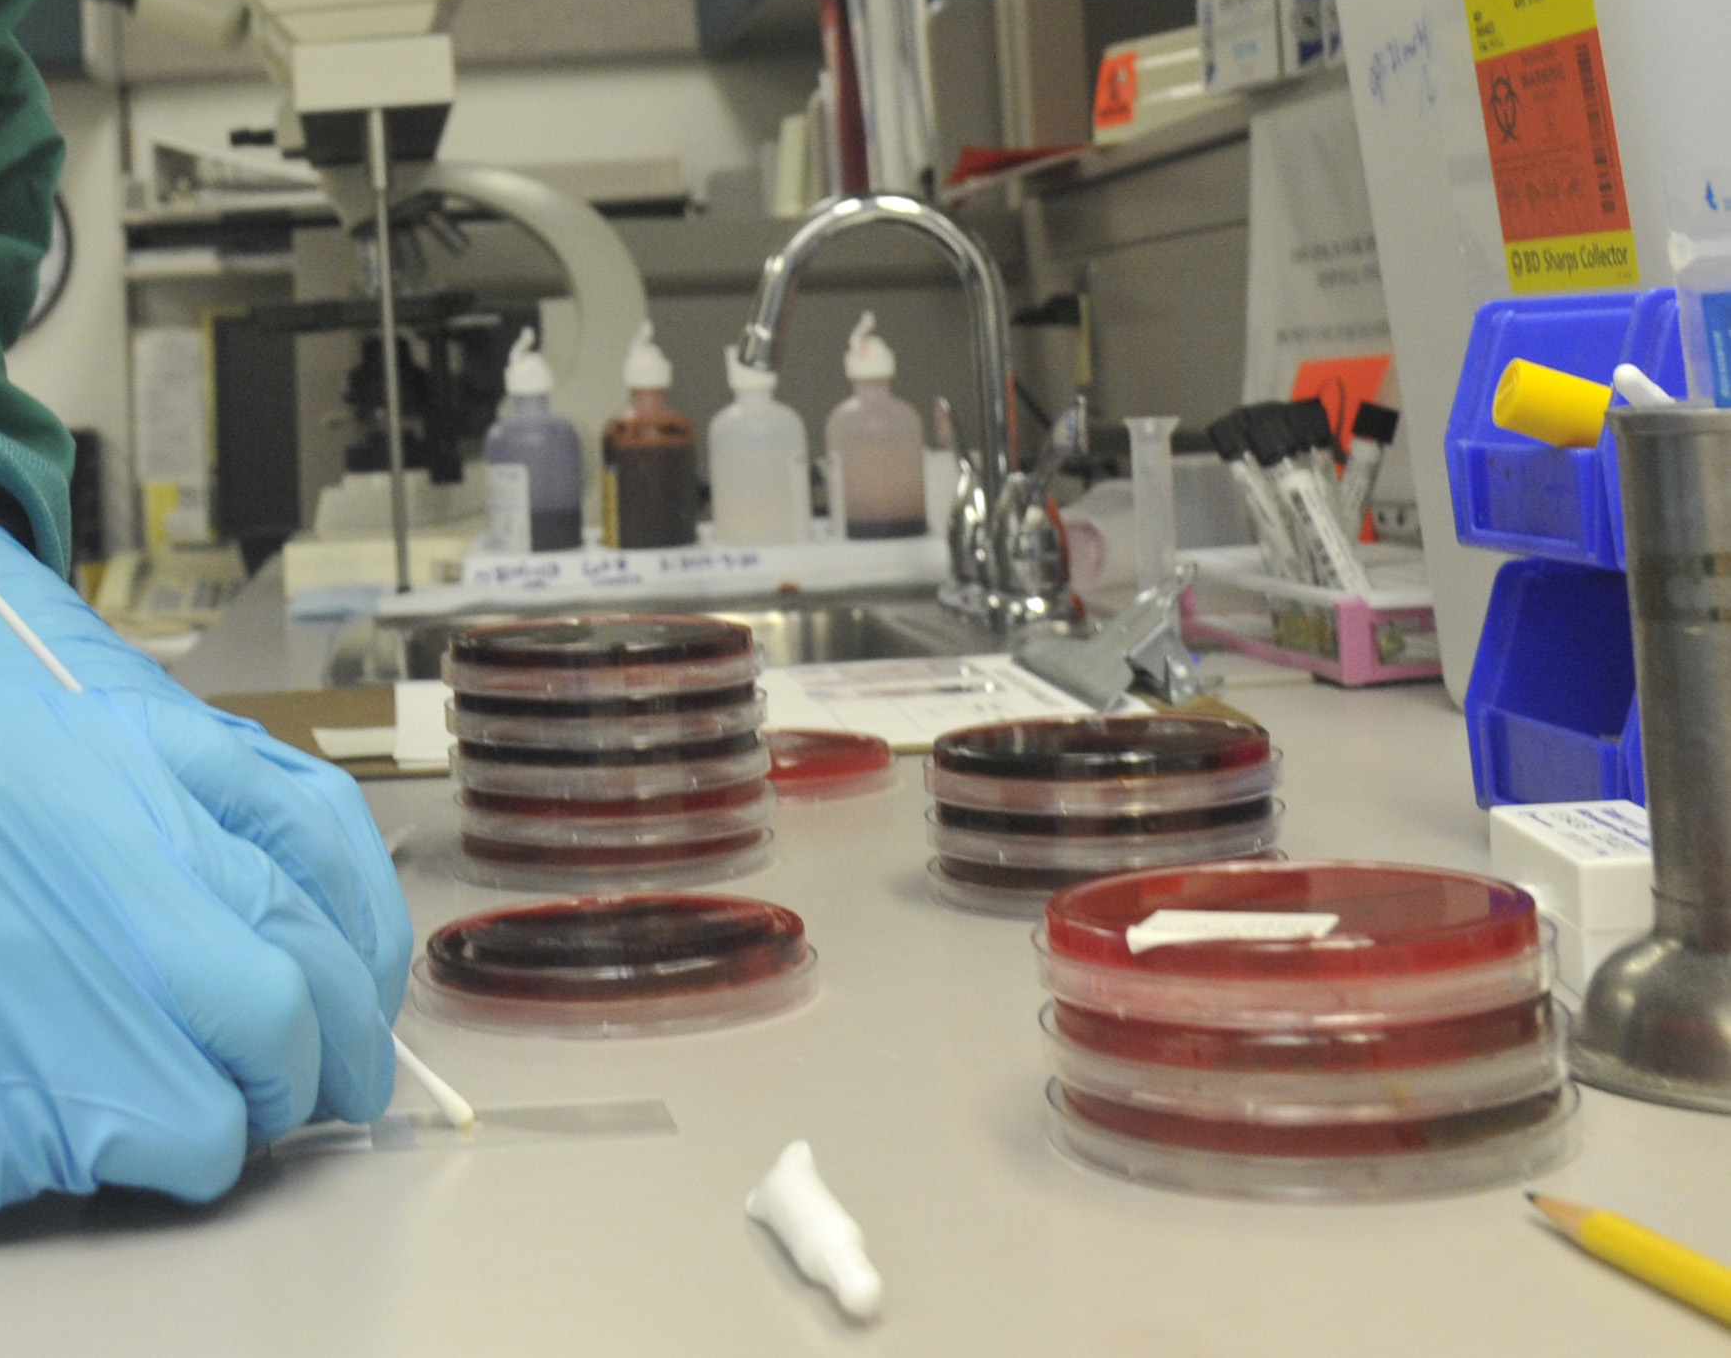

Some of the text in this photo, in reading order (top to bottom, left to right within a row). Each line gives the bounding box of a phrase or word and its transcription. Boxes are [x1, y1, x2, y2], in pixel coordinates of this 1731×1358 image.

[1523, 243, 1629, 274] BD Sharps Collector
